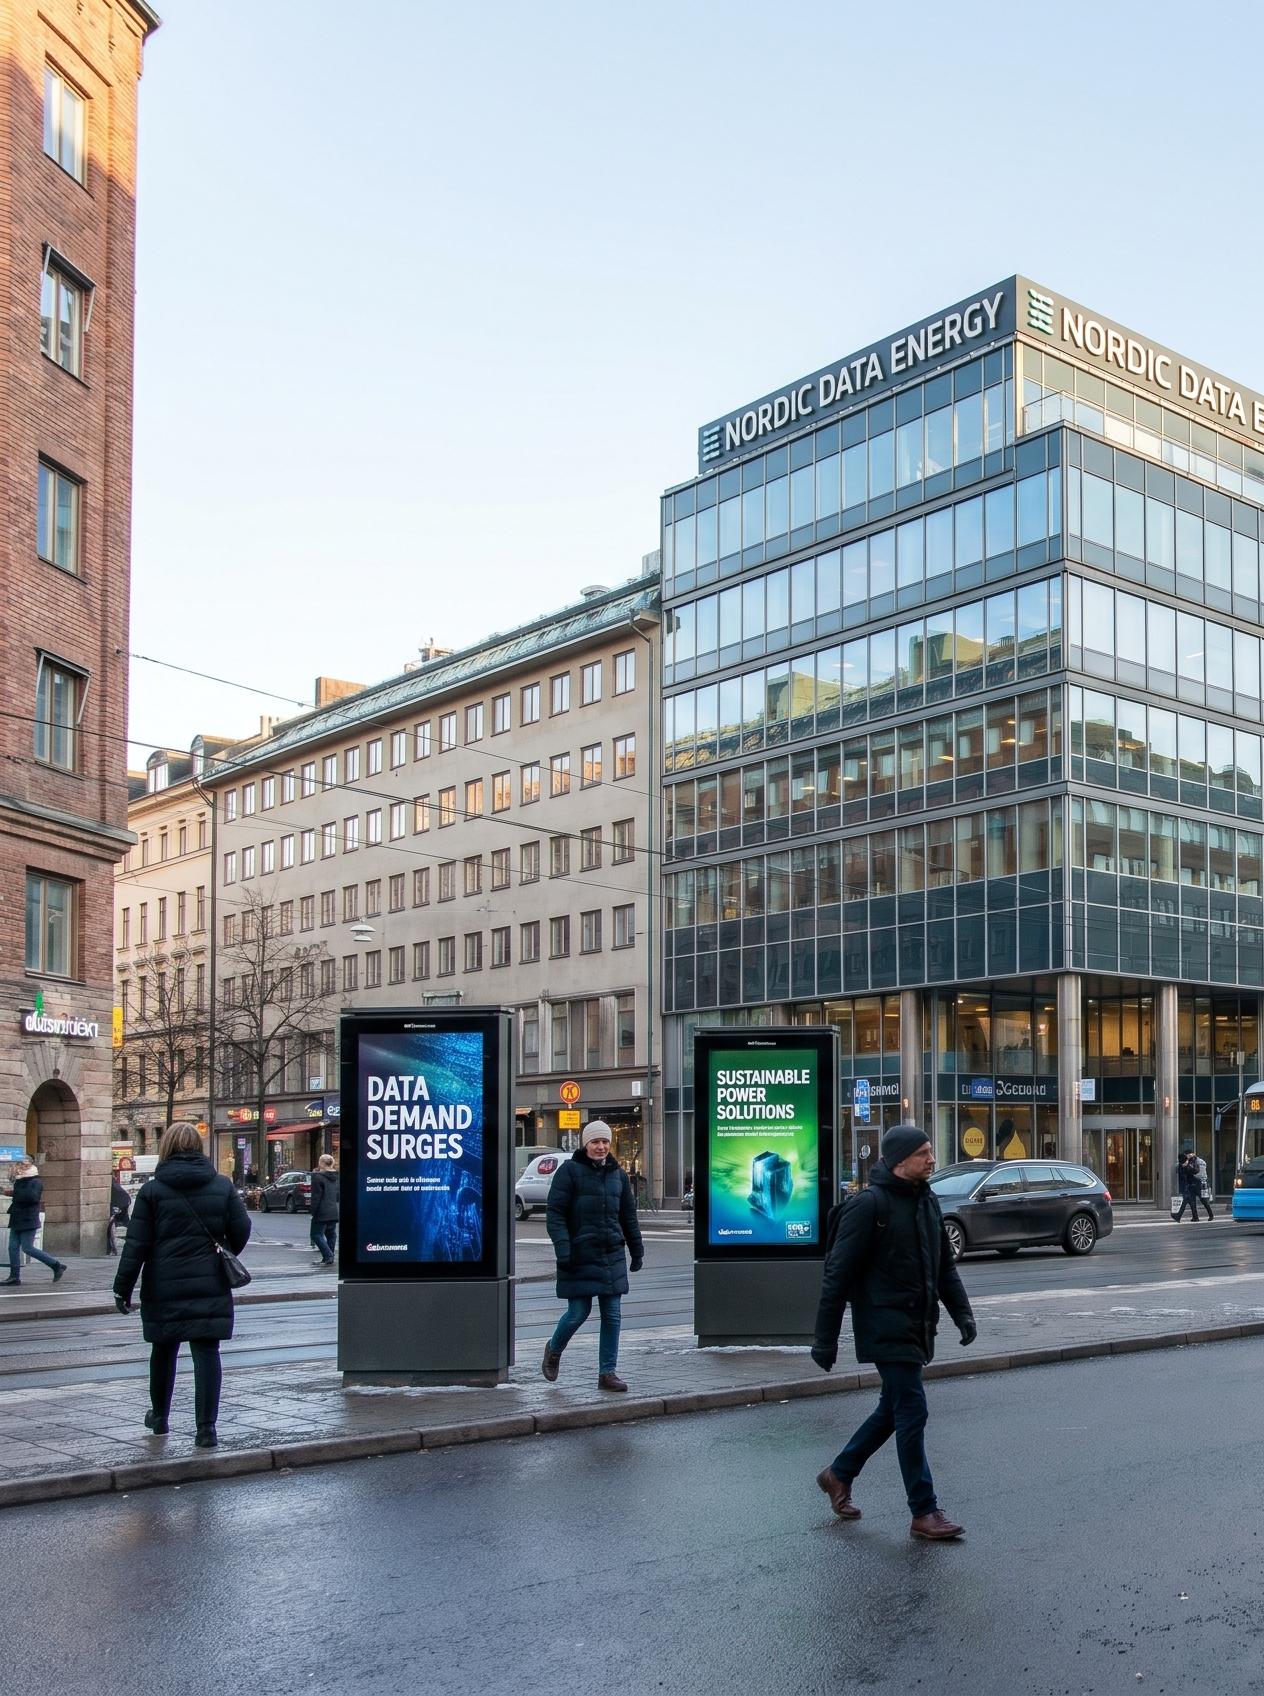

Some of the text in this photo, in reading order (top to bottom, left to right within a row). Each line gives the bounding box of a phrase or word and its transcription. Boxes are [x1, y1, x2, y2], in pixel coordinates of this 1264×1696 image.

[724, 292, 1004, 450] NORDIC DATA ENERGY
[1062, 306, 1172, 389] NORDIC
[1180, 362, 1246, 426] DATA
[367, 1075, 430, 1102] DATA
[716, 1069, 810, 1085] SUSTAINABLE
[716, 1087, 767, 1102] POWER
[367, 1104, 473, 1131] DEMAND
[716, 1104, 795, 1120] SOLUTIONS
[366, 1133, 463, 1160] SURGES
